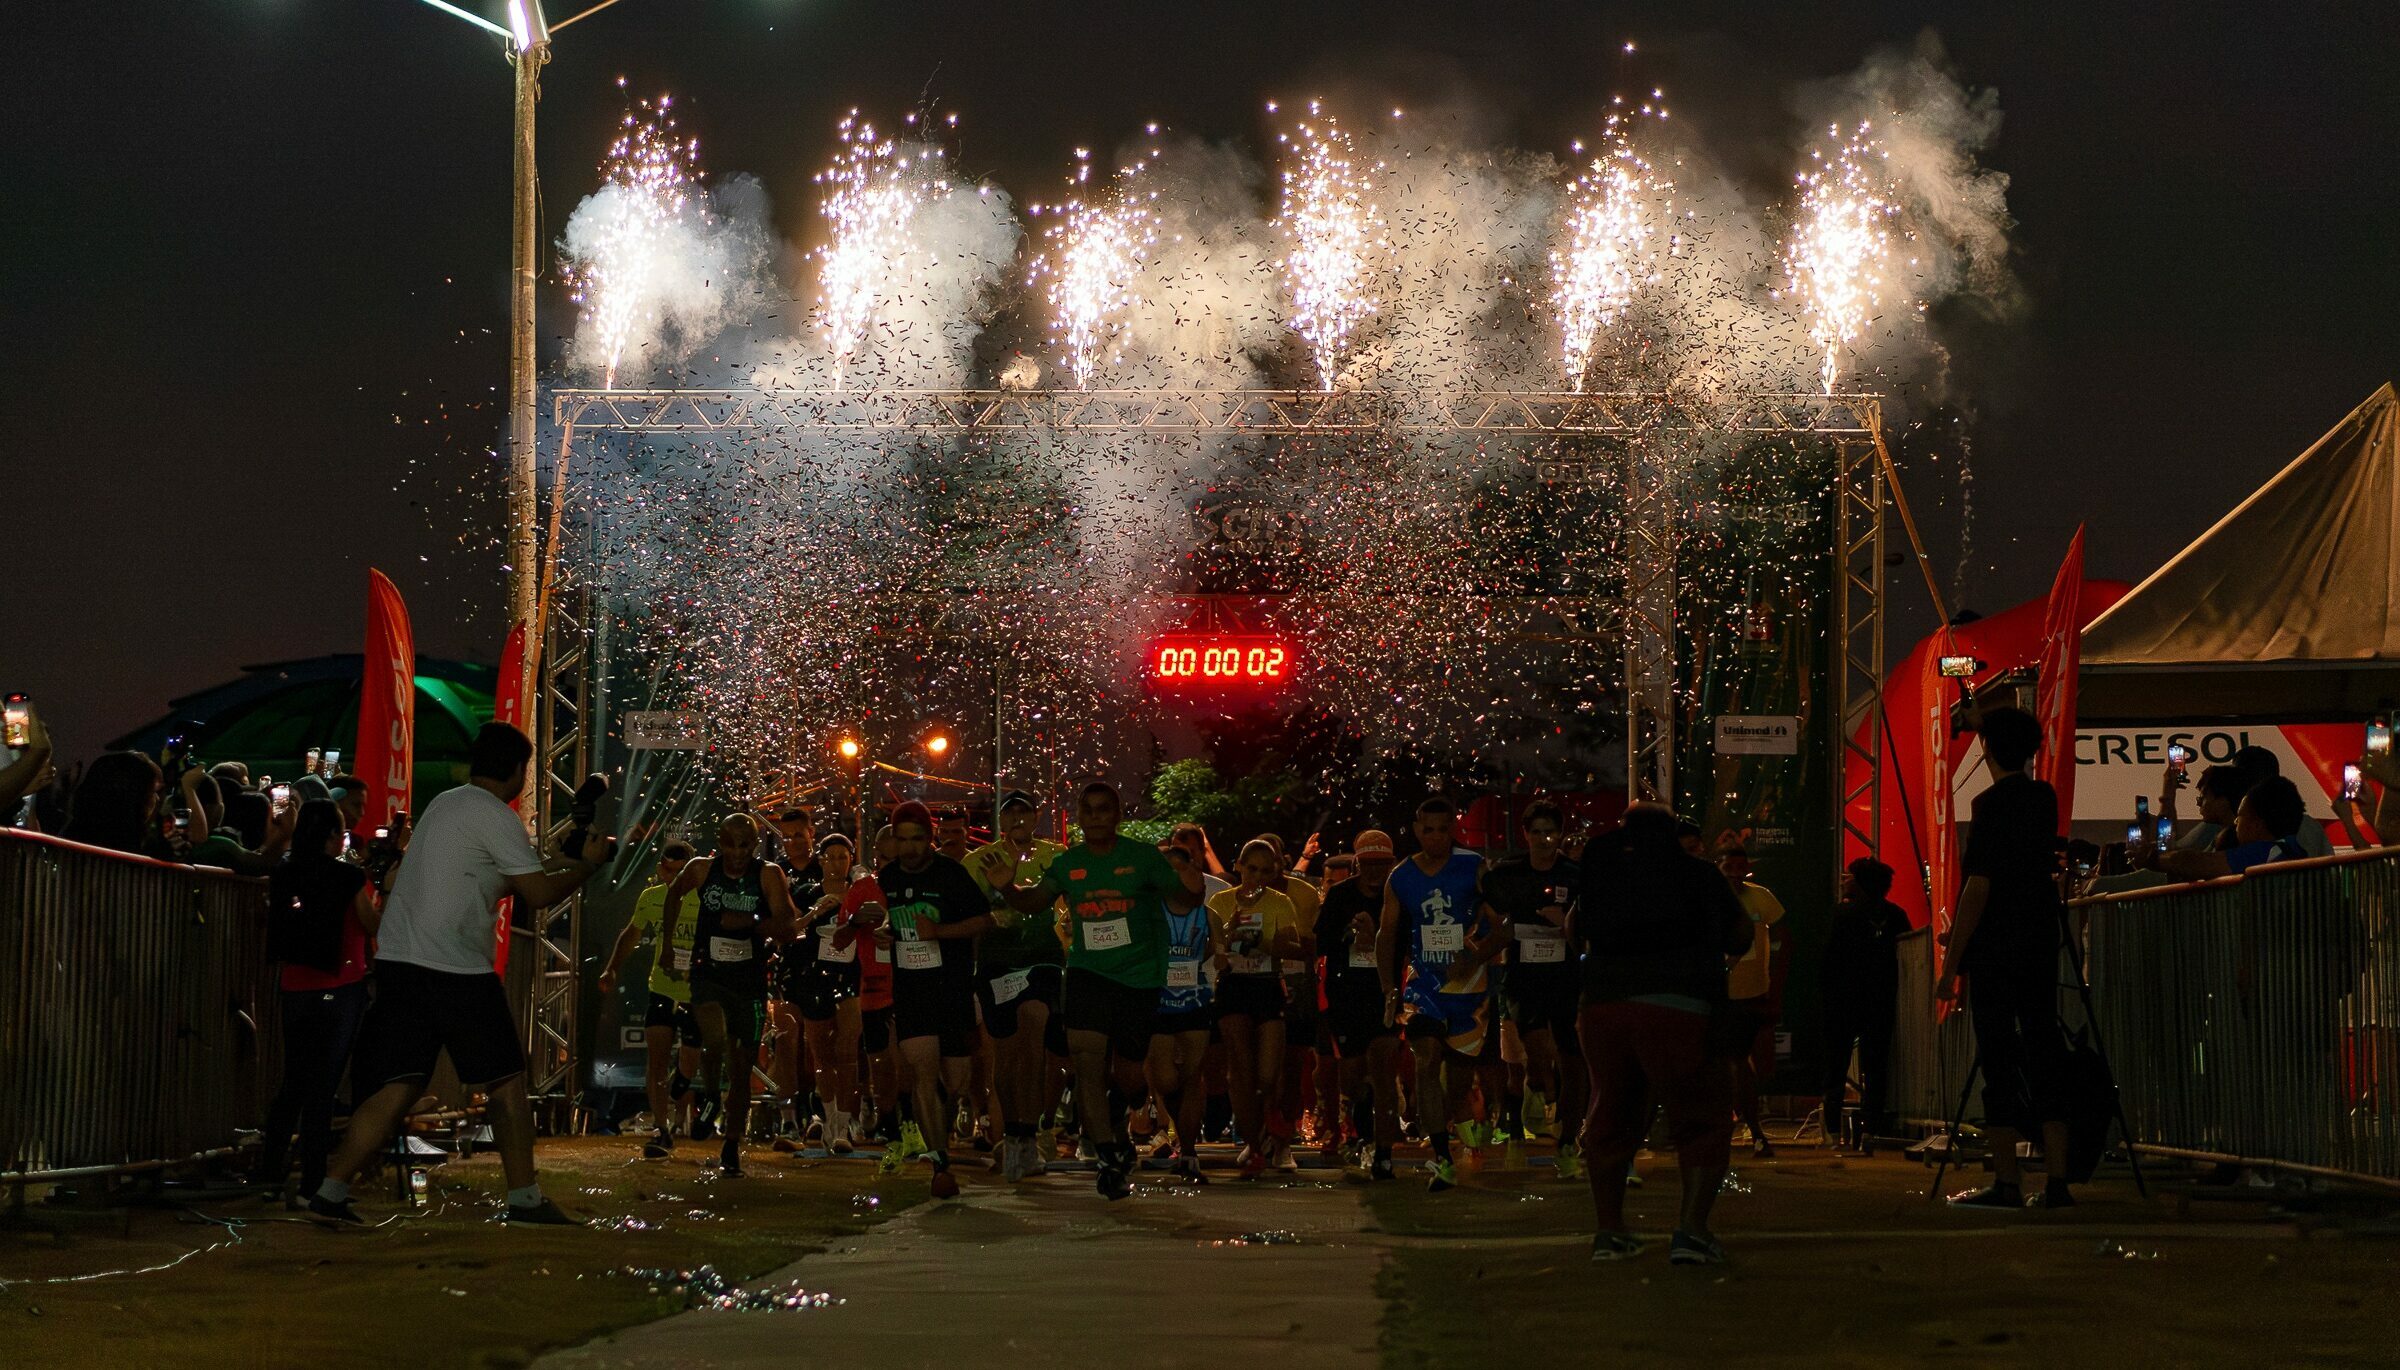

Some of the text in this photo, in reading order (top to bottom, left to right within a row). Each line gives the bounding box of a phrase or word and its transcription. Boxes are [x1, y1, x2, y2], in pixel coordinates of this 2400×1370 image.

[1160, 648, 1284, 676] 00 00 02
[387, 640, 409, 826] RESOL
[1723, 726, 1770, 735] Unimed
